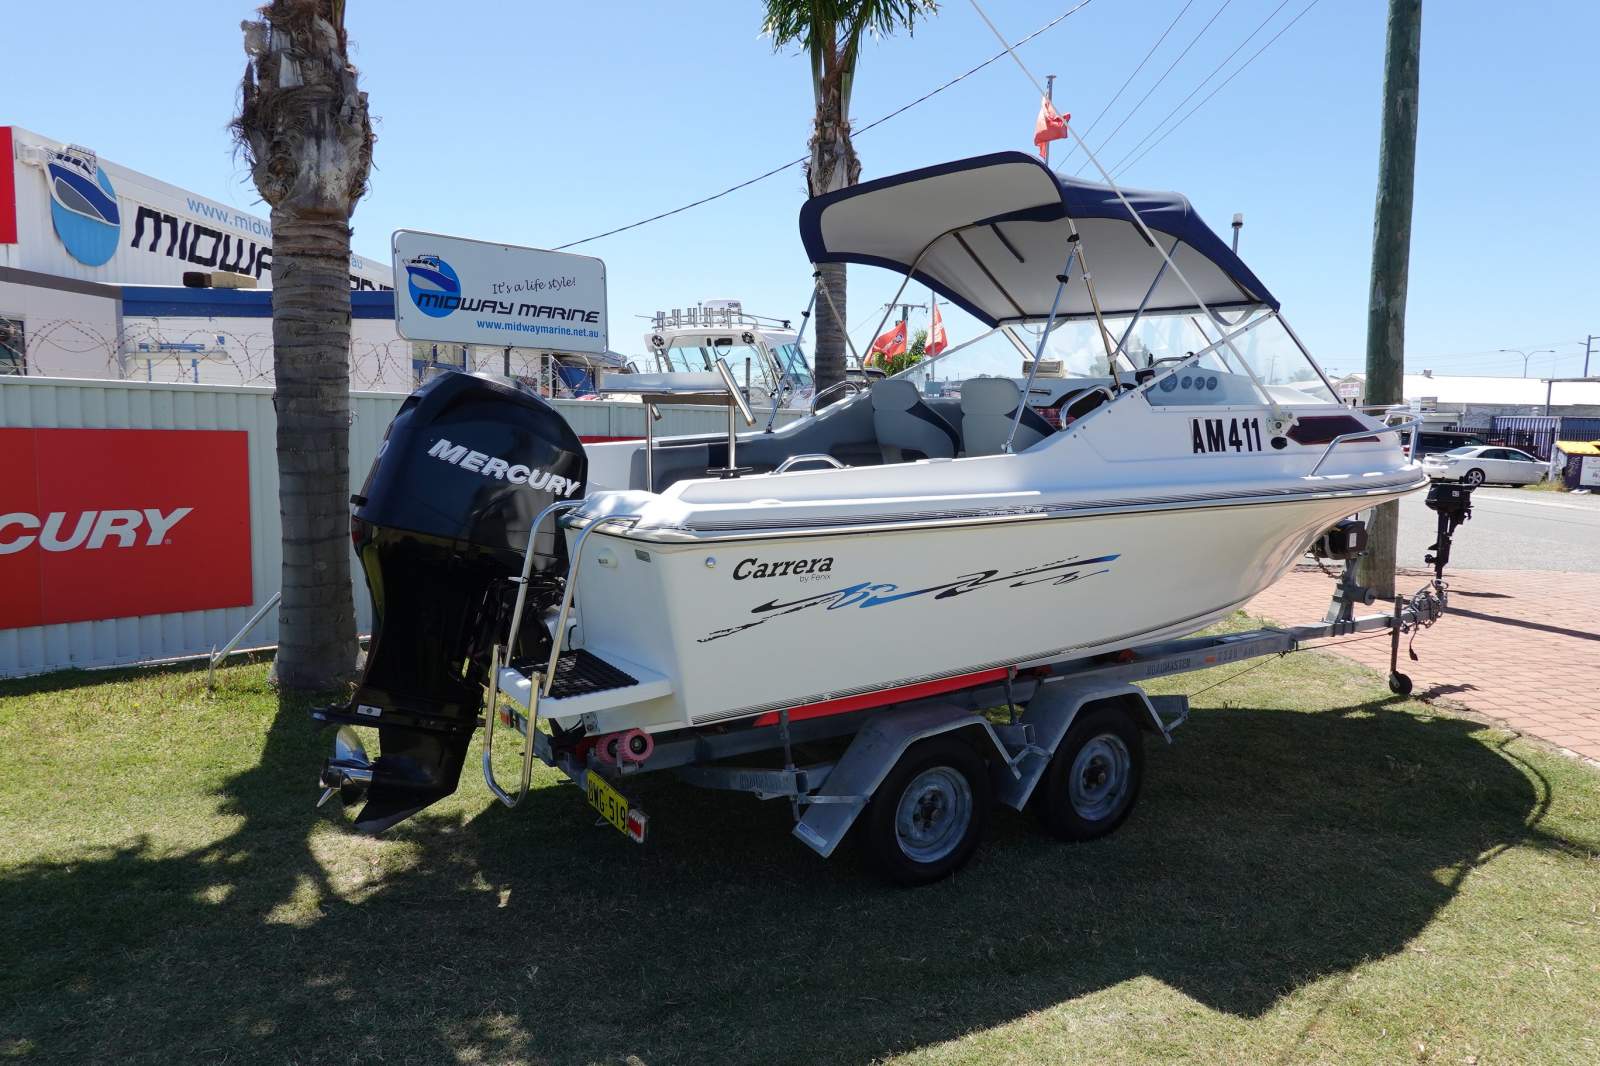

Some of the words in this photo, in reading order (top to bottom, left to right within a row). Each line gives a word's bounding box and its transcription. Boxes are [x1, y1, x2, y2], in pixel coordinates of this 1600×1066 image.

[492, 282, 512, 294] It's
[514, 283, 525, 293] a
[526, 280, 545, 293] life
[548, 276, 577, 291] style!
[417, 294, 514, 315] MIDWAY
[518, 304, 600, 323] MARINE
[476, 319, 599, 337] www.midwaymarine.net.au
[427, 438, 581, 498] MERCURY
[733, 557, 834, 581] Carrera
[799, 575, 809, 584] by
[811, 573, 832, 582] Fenix
